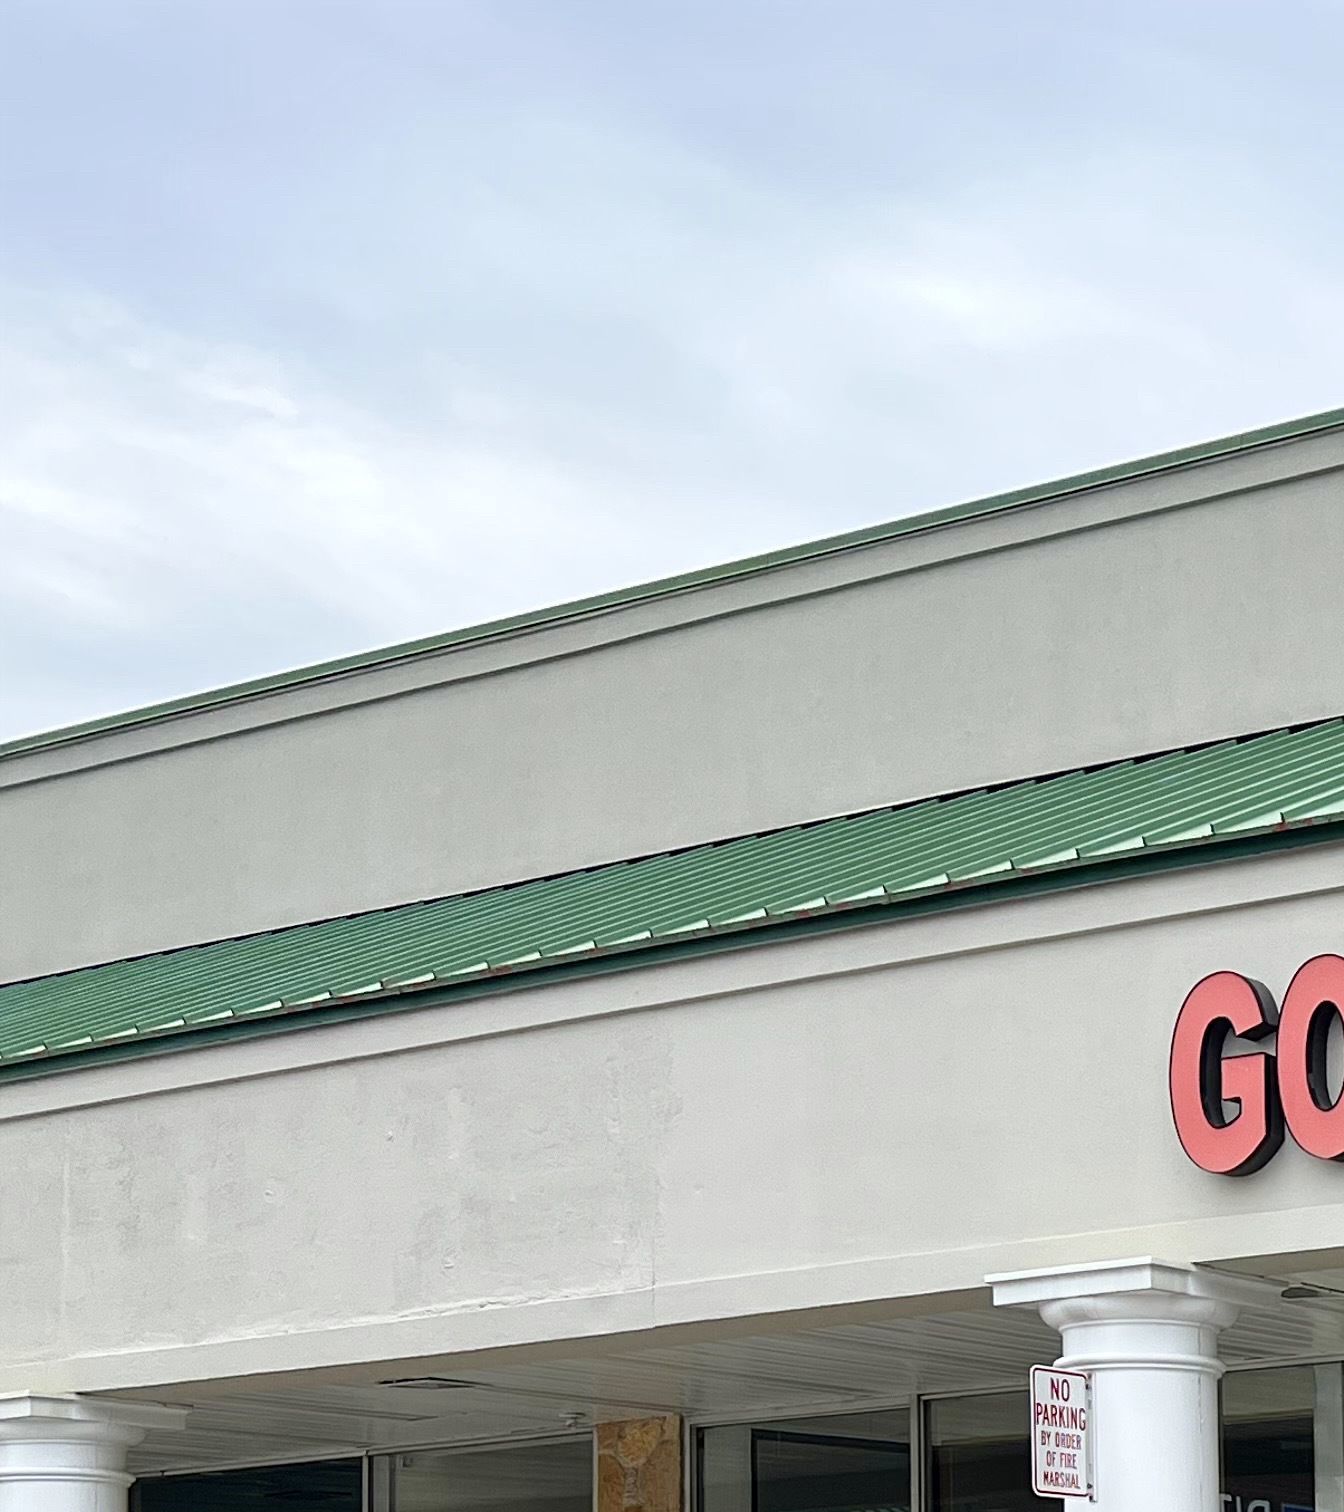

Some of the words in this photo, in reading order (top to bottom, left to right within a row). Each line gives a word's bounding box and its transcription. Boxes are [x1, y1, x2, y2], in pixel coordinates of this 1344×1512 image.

[1050, 1377, 1070, 1402] NO
[1036, 1402, 1086, 1431] PARKING
[1041, 1430, 1052, 1446] BY
[1055, 1432, 1082, 1450] ORDER
[1046, 1450, 1056, 1467] OF
[1060, 1452, 1077, 1469] FIRE
[1043, 1471, 1081, 1489] MARSHAL
